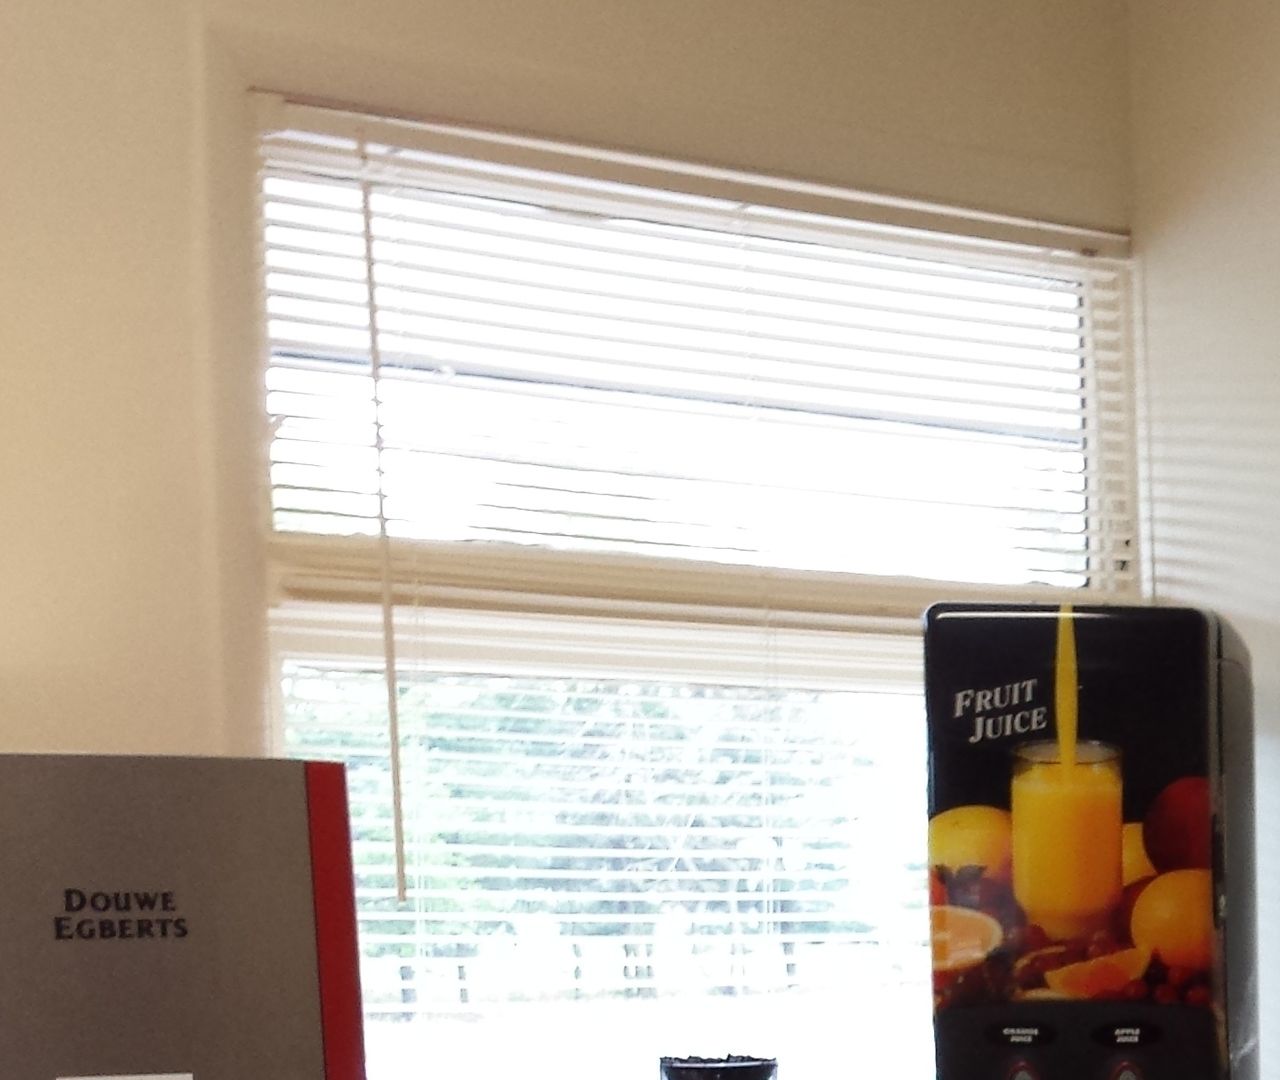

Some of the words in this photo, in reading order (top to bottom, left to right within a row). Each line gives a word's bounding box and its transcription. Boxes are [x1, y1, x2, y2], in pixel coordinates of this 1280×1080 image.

[953, 678, 1038, 718] FRUIT
[968, 706, 1048, 744] JUICE
[64, 888, 176, 912] DOUWE
[54, 916, 189, 941] EGBERTS
